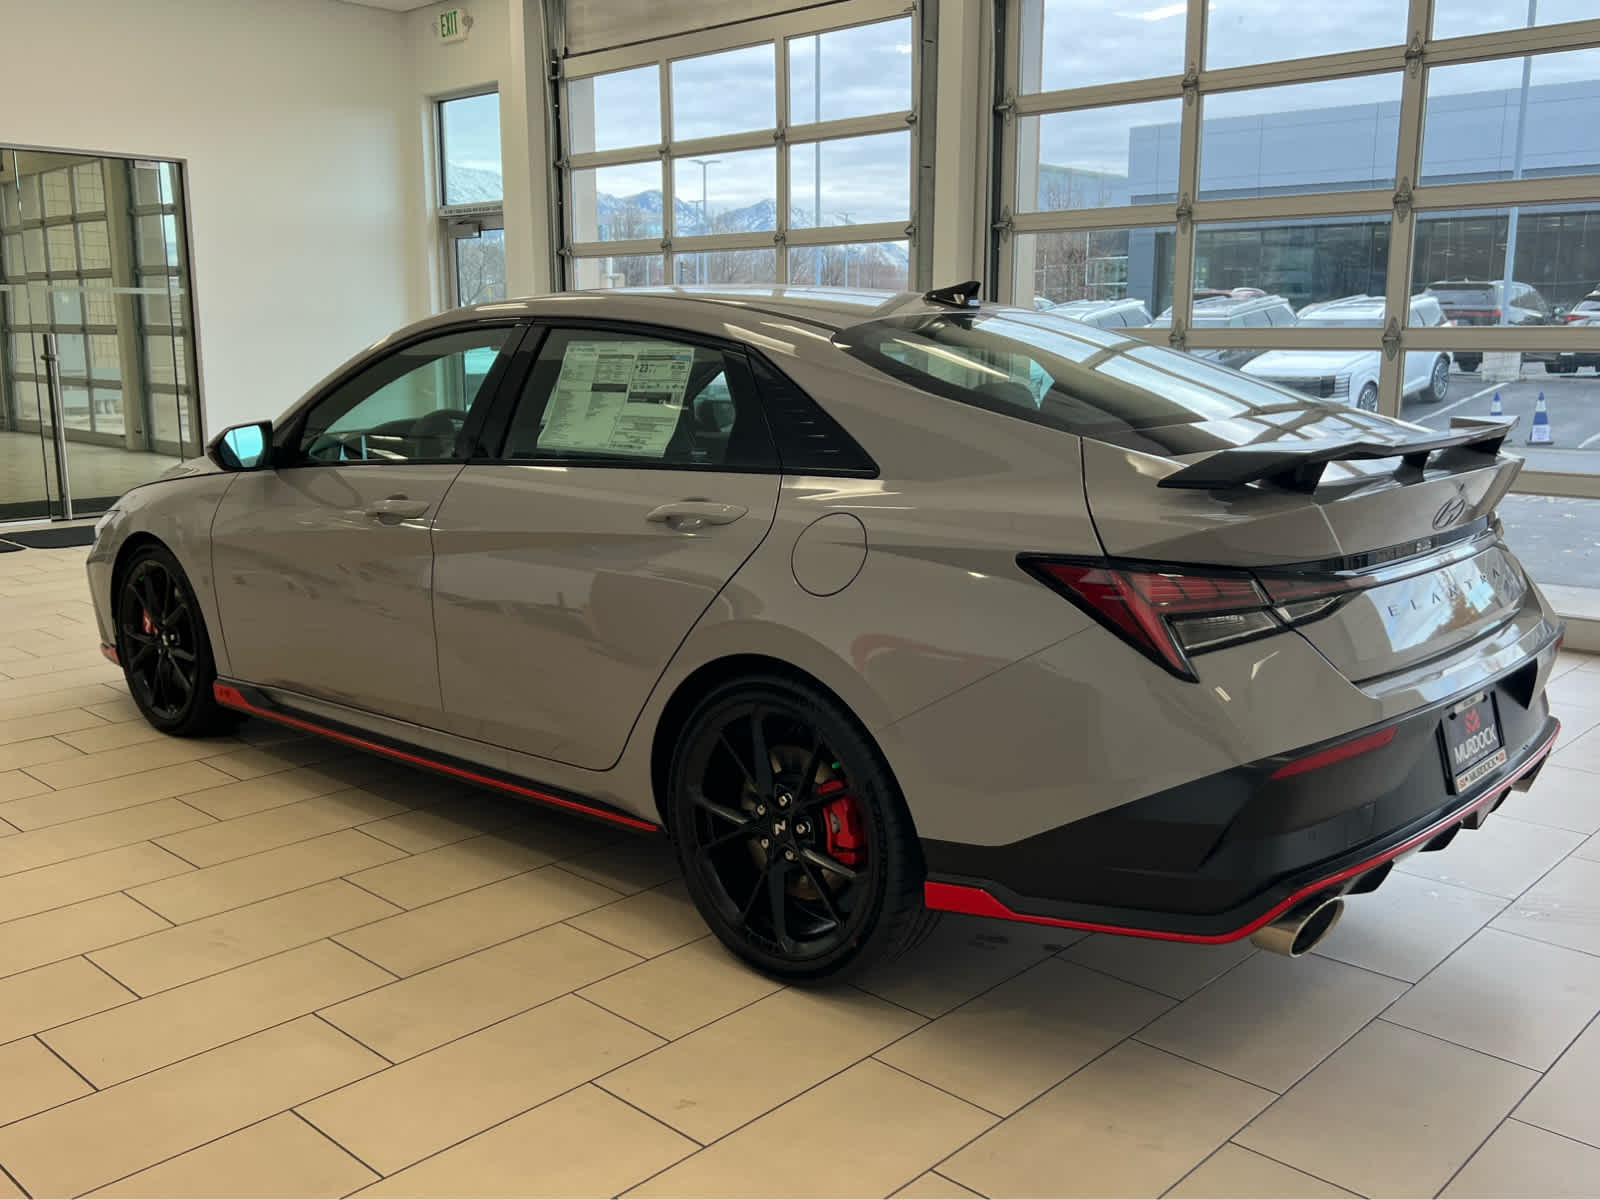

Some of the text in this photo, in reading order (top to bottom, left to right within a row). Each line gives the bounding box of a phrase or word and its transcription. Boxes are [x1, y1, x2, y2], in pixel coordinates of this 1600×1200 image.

[440, 10, 458, 37] EXIT
[1387, 567, 1501, 617] ELANTRA
[1454, 723, 1497, 764] MURDOCK
